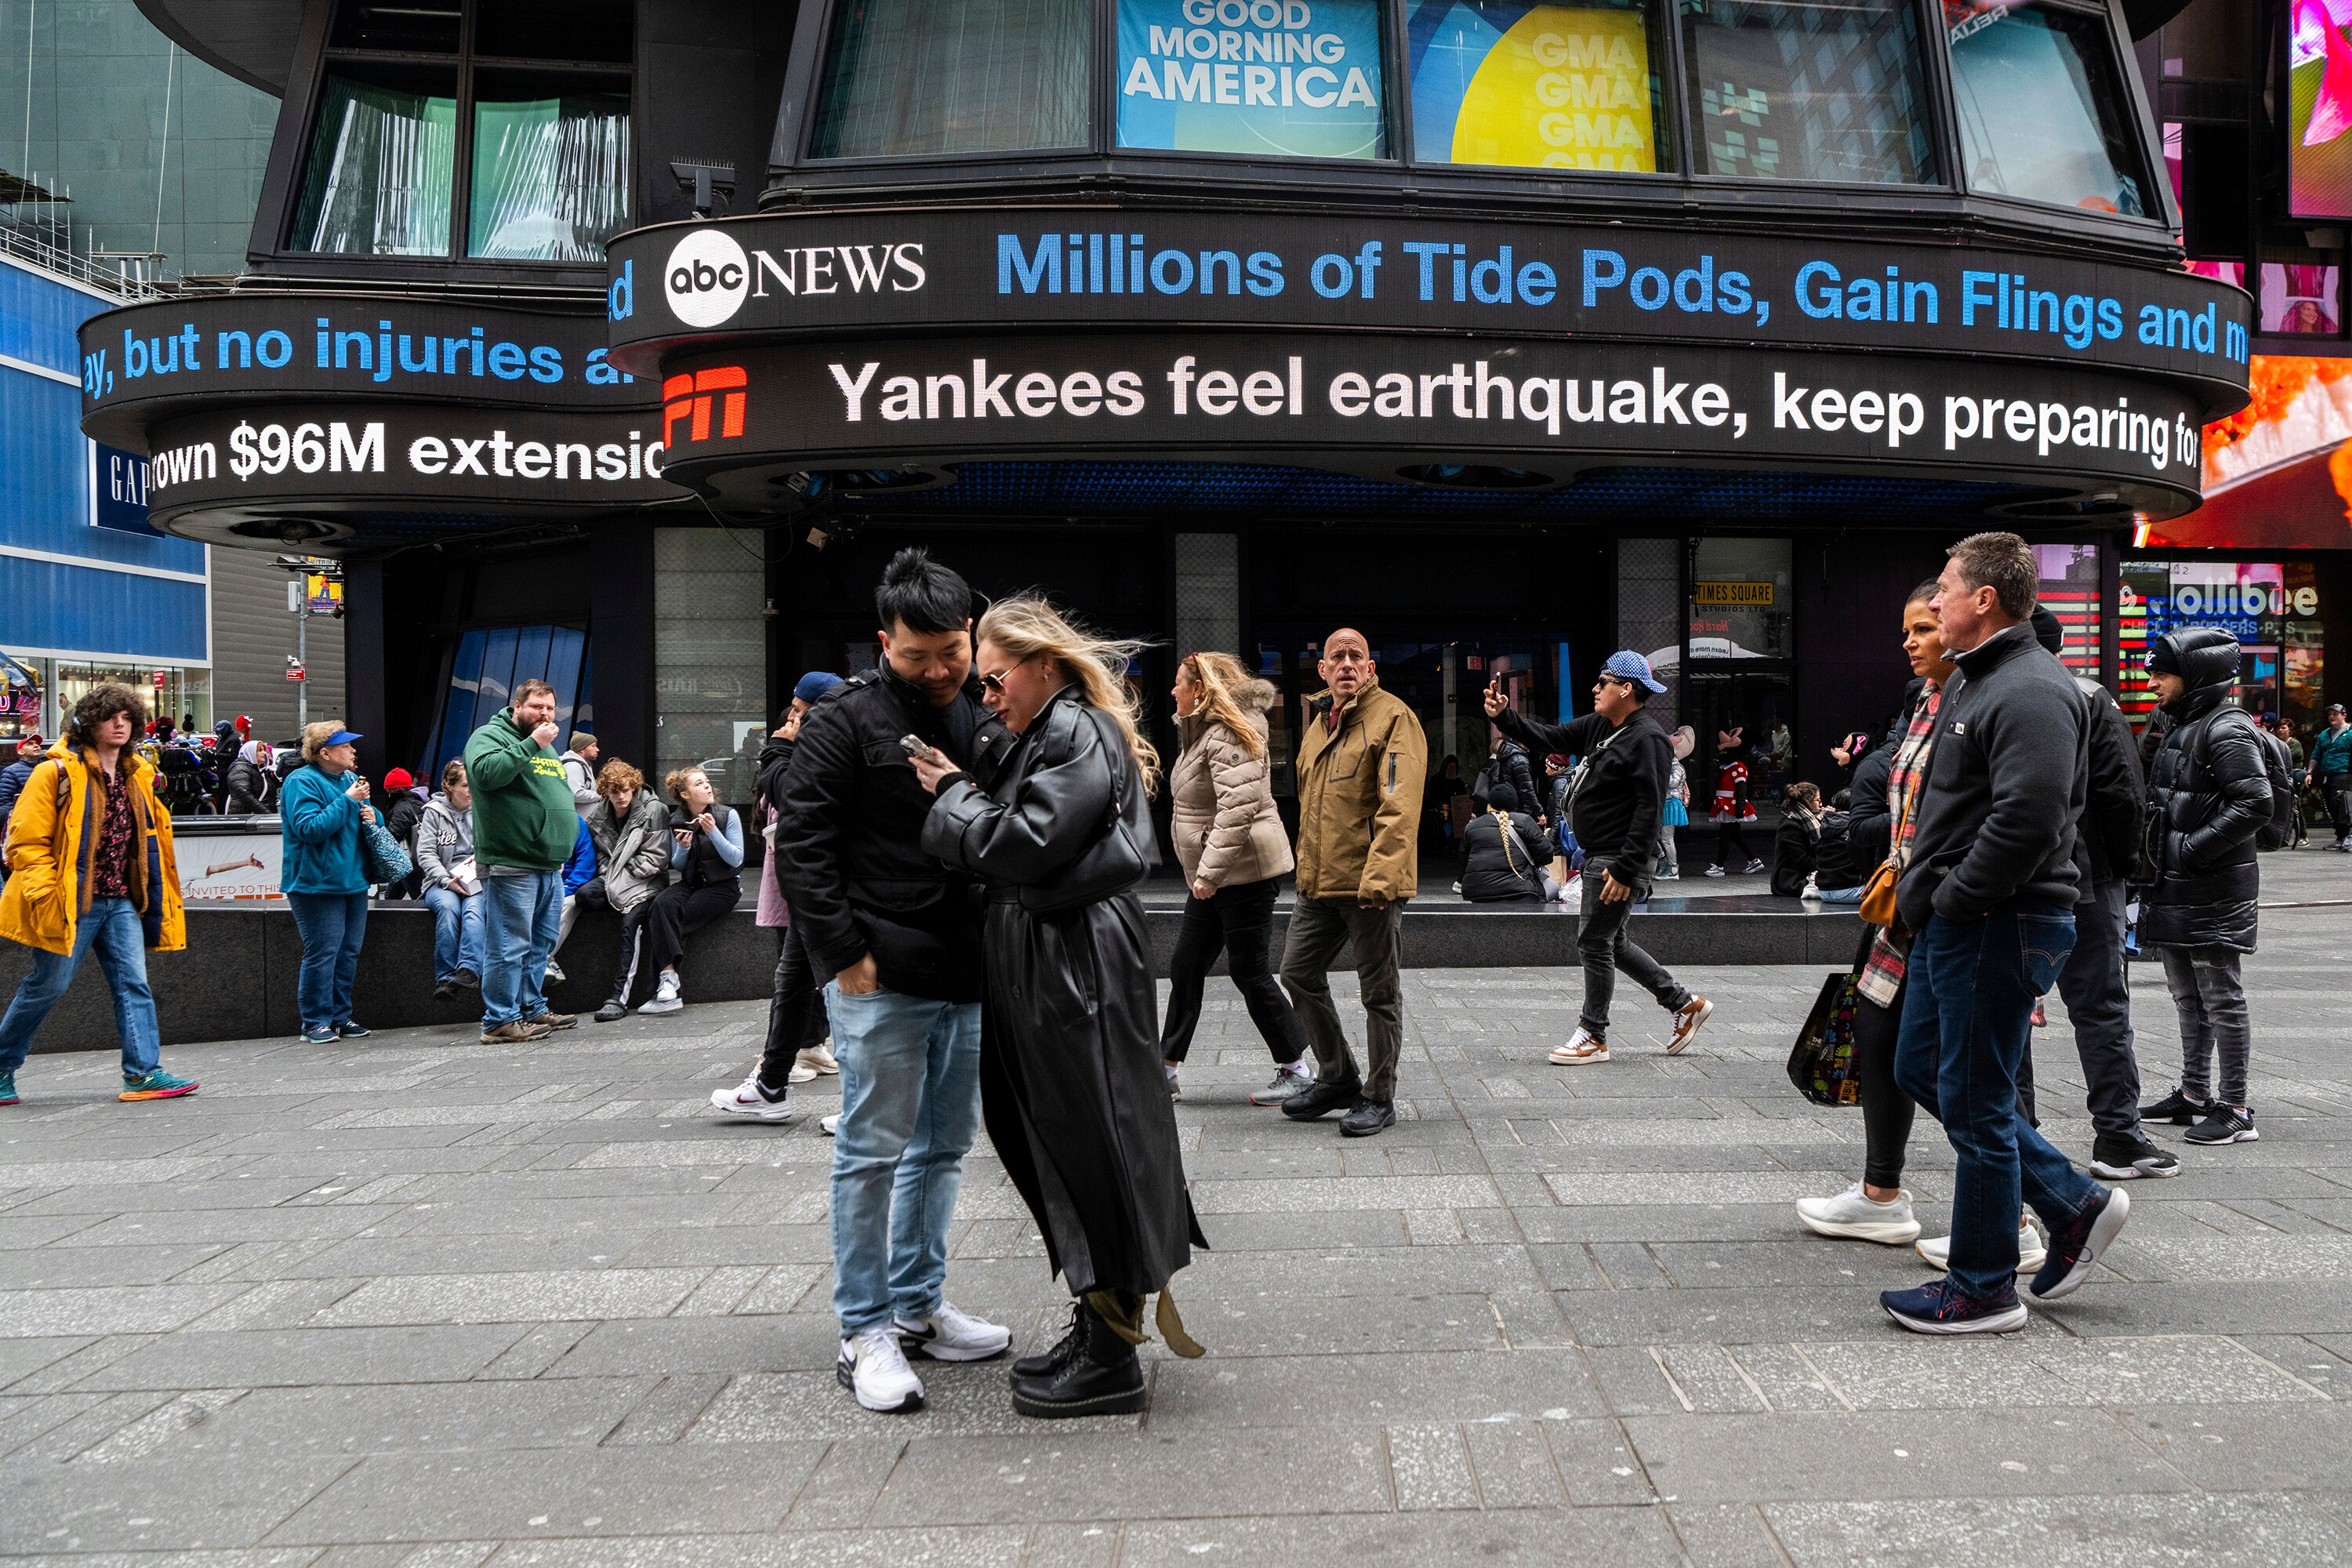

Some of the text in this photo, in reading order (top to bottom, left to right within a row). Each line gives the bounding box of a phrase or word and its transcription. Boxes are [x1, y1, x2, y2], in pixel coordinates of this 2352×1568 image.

[1182, 0, 1312, 31] GOOD
[1149, 27, 1345, 64] MORNING
[1532, 33, 1638, 69] GMA
[1123, 57, 1377, 109] AMERICA
[1535, 74, 1642, 110] GMA
[1538, 112, 1644, 149] GMA
[608, 259, 633, 323] d
[670, 244, 925, 296] abc NEWS
[997, 234, 2249, 365] Millions of Tide Pods, Gain Flings and m
[84, 349, 114, 401] ay,
[124, 323, 201, 379] but
[218, 330, 293, 368] no
[317, 318, 564, 383] injuries
[828, 359, 1145, 422] Yankees
[1167, 356, 1302, 416] feel
[1330, 361, 1747, 439] earthquake,
[1773, 372, 1924, 448] keep
[1945, 397, 2169, 470] preparing
[111, 455, 150, 506] GAP
[152, 441, 216, 492] rown
[229, 420, 385, 482] $96M
[1697, 585, 1770, 601] TIMES SQUARE
[188, 885, 237, 895] INVITED
[238, 885, 255, 895] TO
[258, 884, 281, 894] THIS
